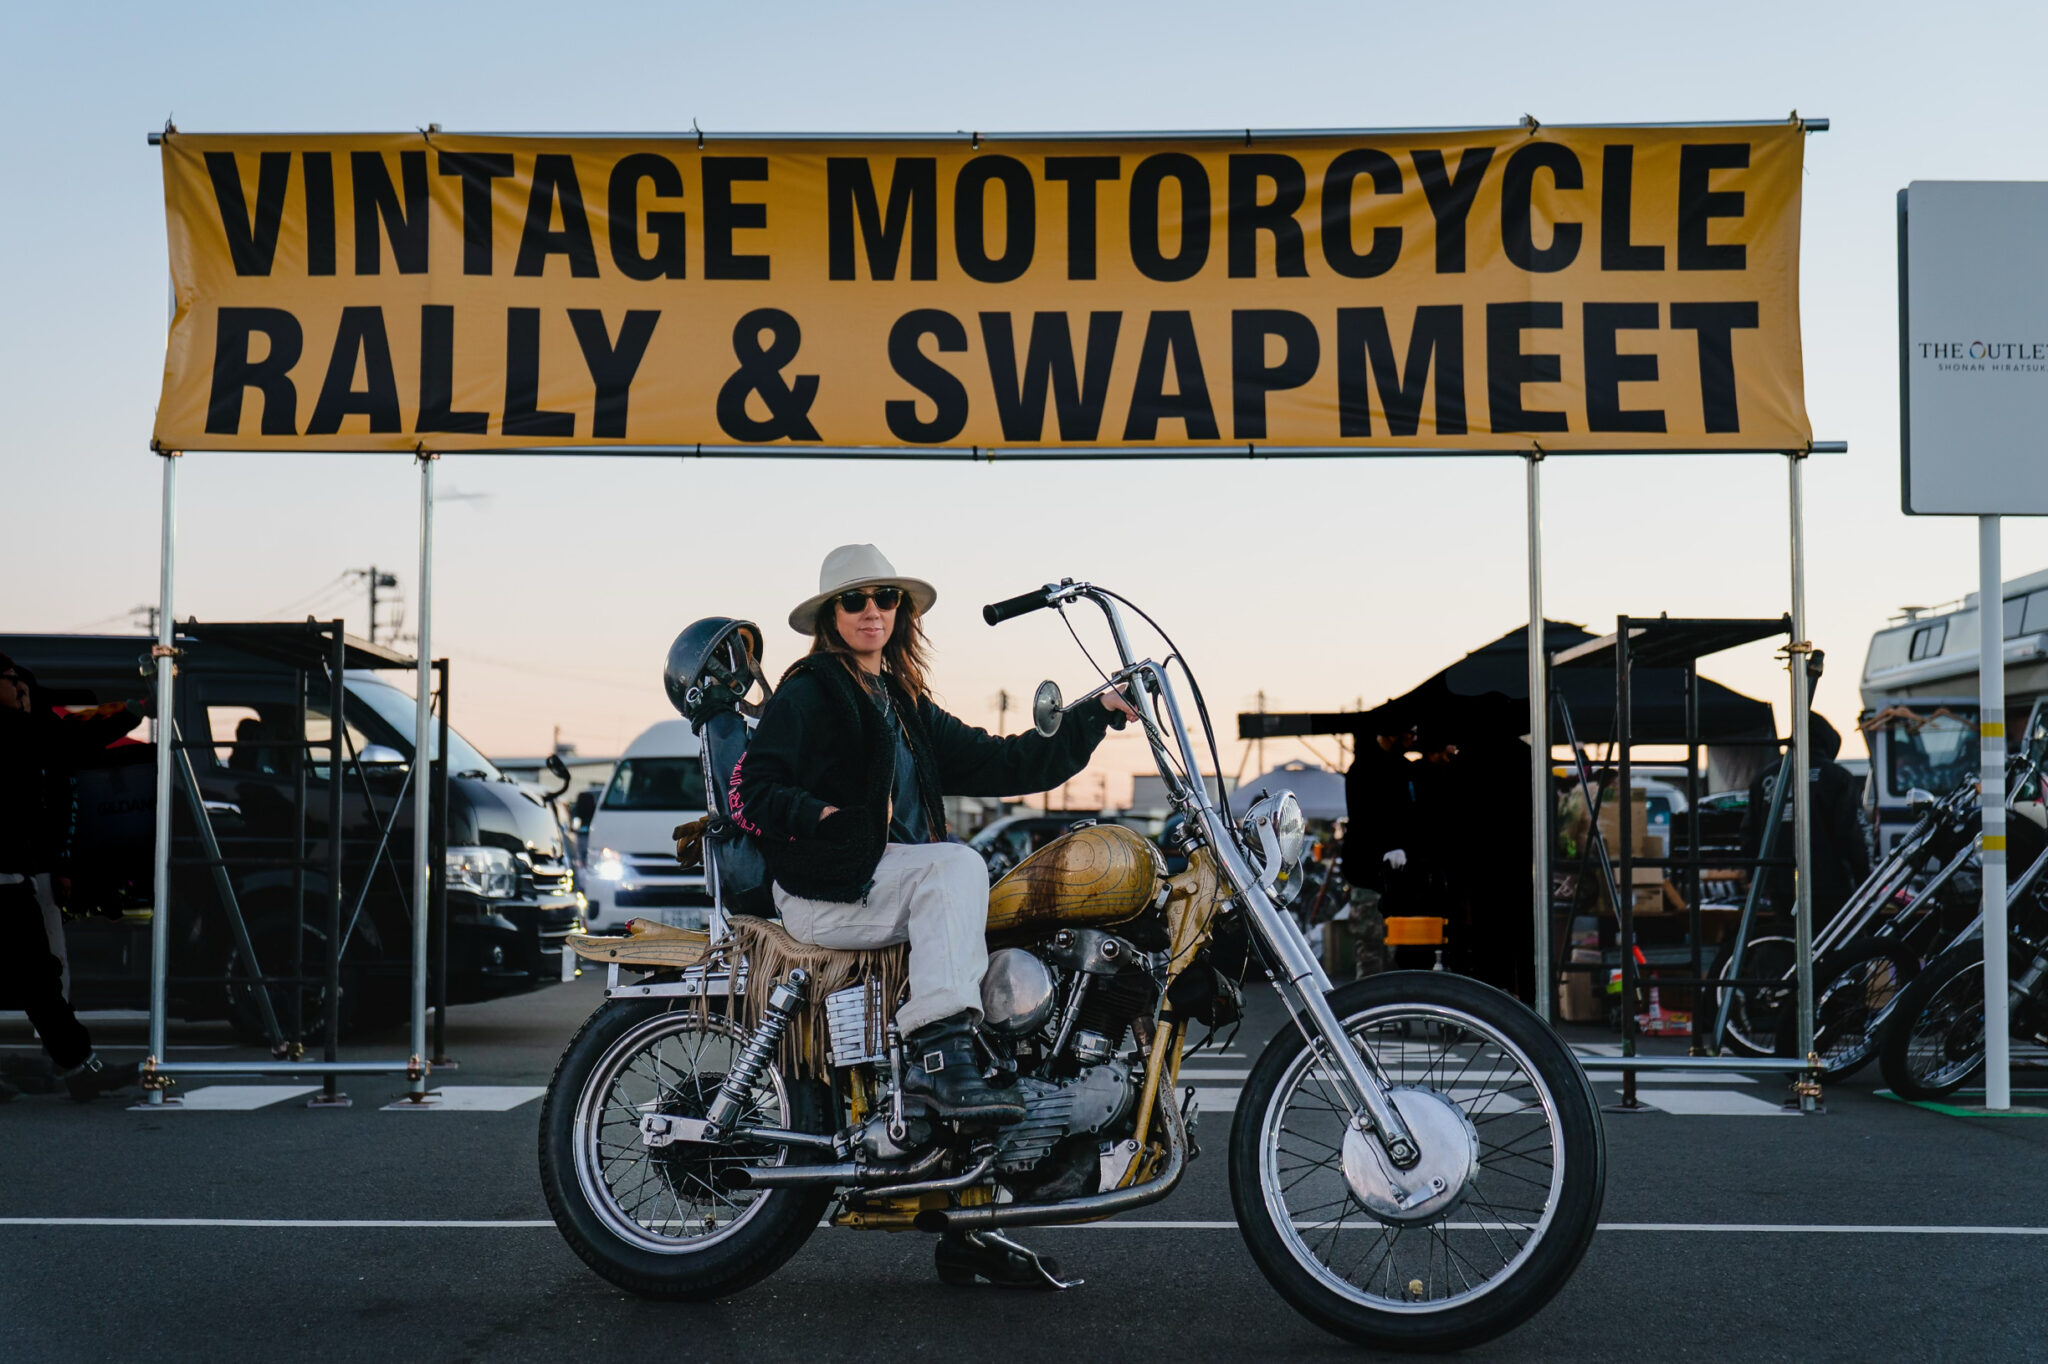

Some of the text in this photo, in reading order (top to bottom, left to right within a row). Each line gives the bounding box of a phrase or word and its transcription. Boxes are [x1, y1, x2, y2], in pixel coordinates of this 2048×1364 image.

[203, 142, 1751, 283] VINTAGE MOTORCYCLE
[205, 301, 1759, 443] RALLY & SWAPMEET
[1918, 341, 2048, 359] THE OUTLE
[1938, 363, 2048, 371] SHONAN HIRATSUK
